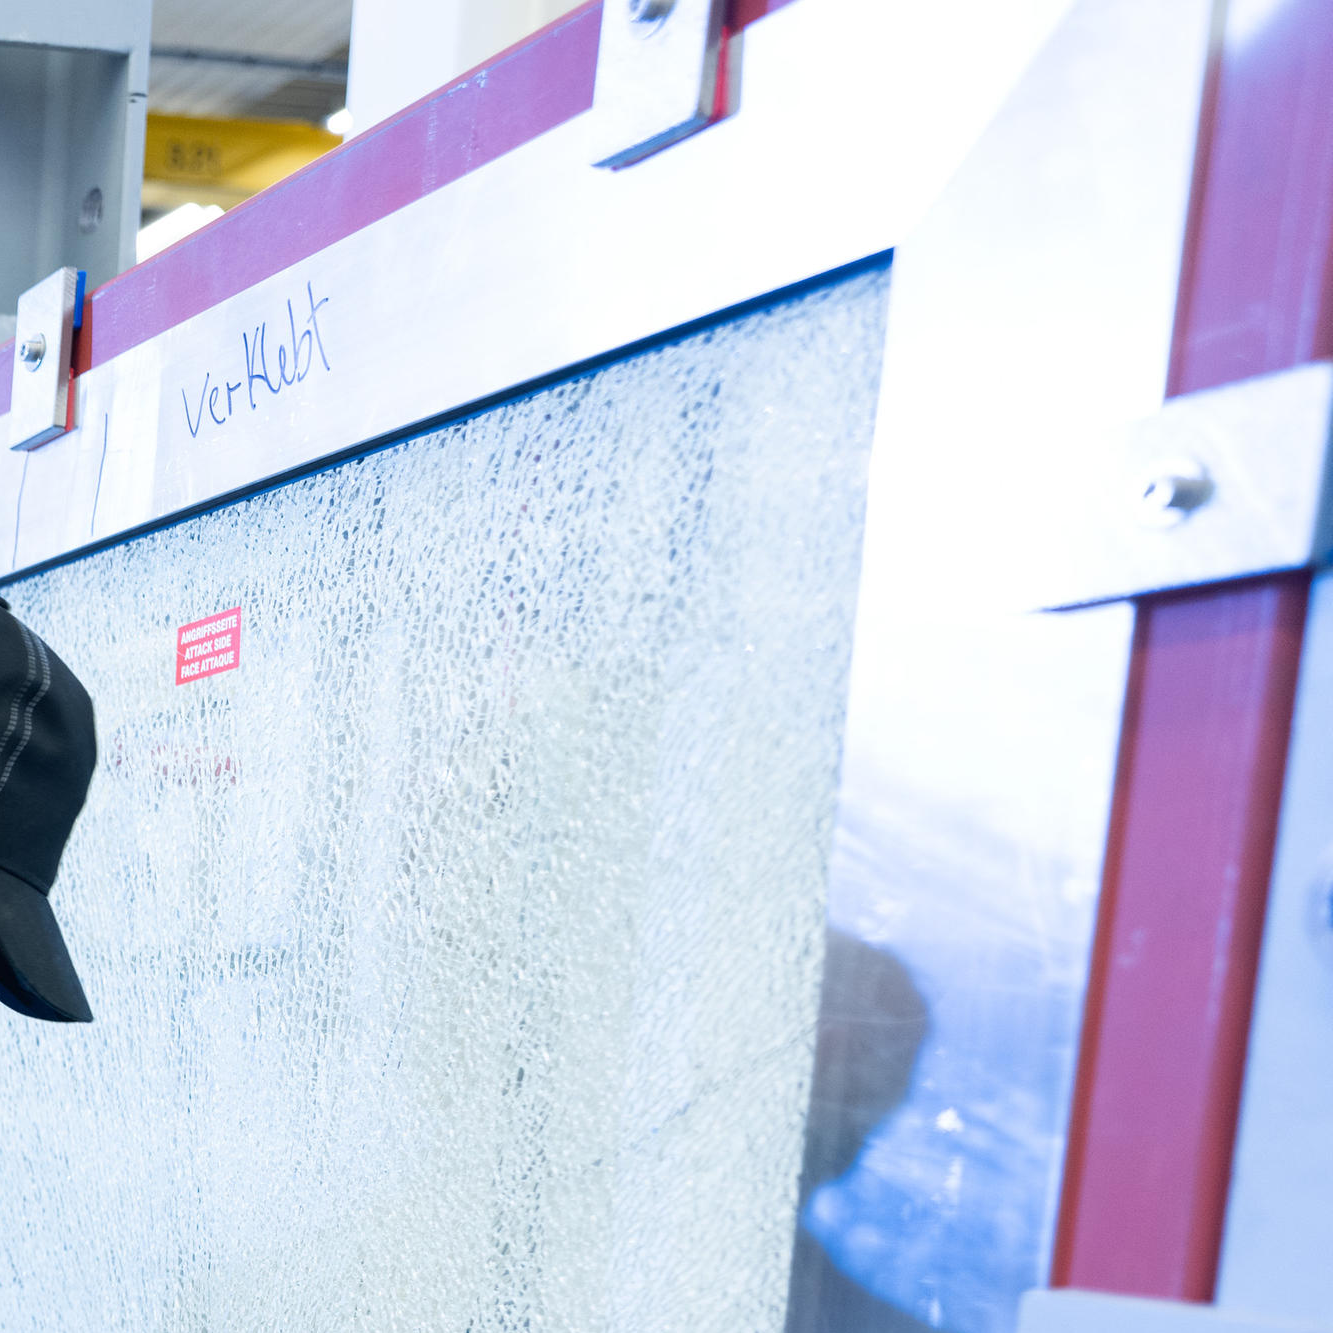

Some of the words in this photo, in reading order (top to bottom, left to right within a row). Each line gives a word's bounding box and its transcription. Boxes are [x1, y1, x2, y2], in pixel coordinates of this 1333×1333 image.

[180, 614, 238, 645] ANGRIFFSSEITE
[184, 640, 213, 661] ATTACK
[214, 633, 232, 651] SIDE
[180, 661, 201, 679] FACE
[200, 650, 235, 673] ATTAQUE
